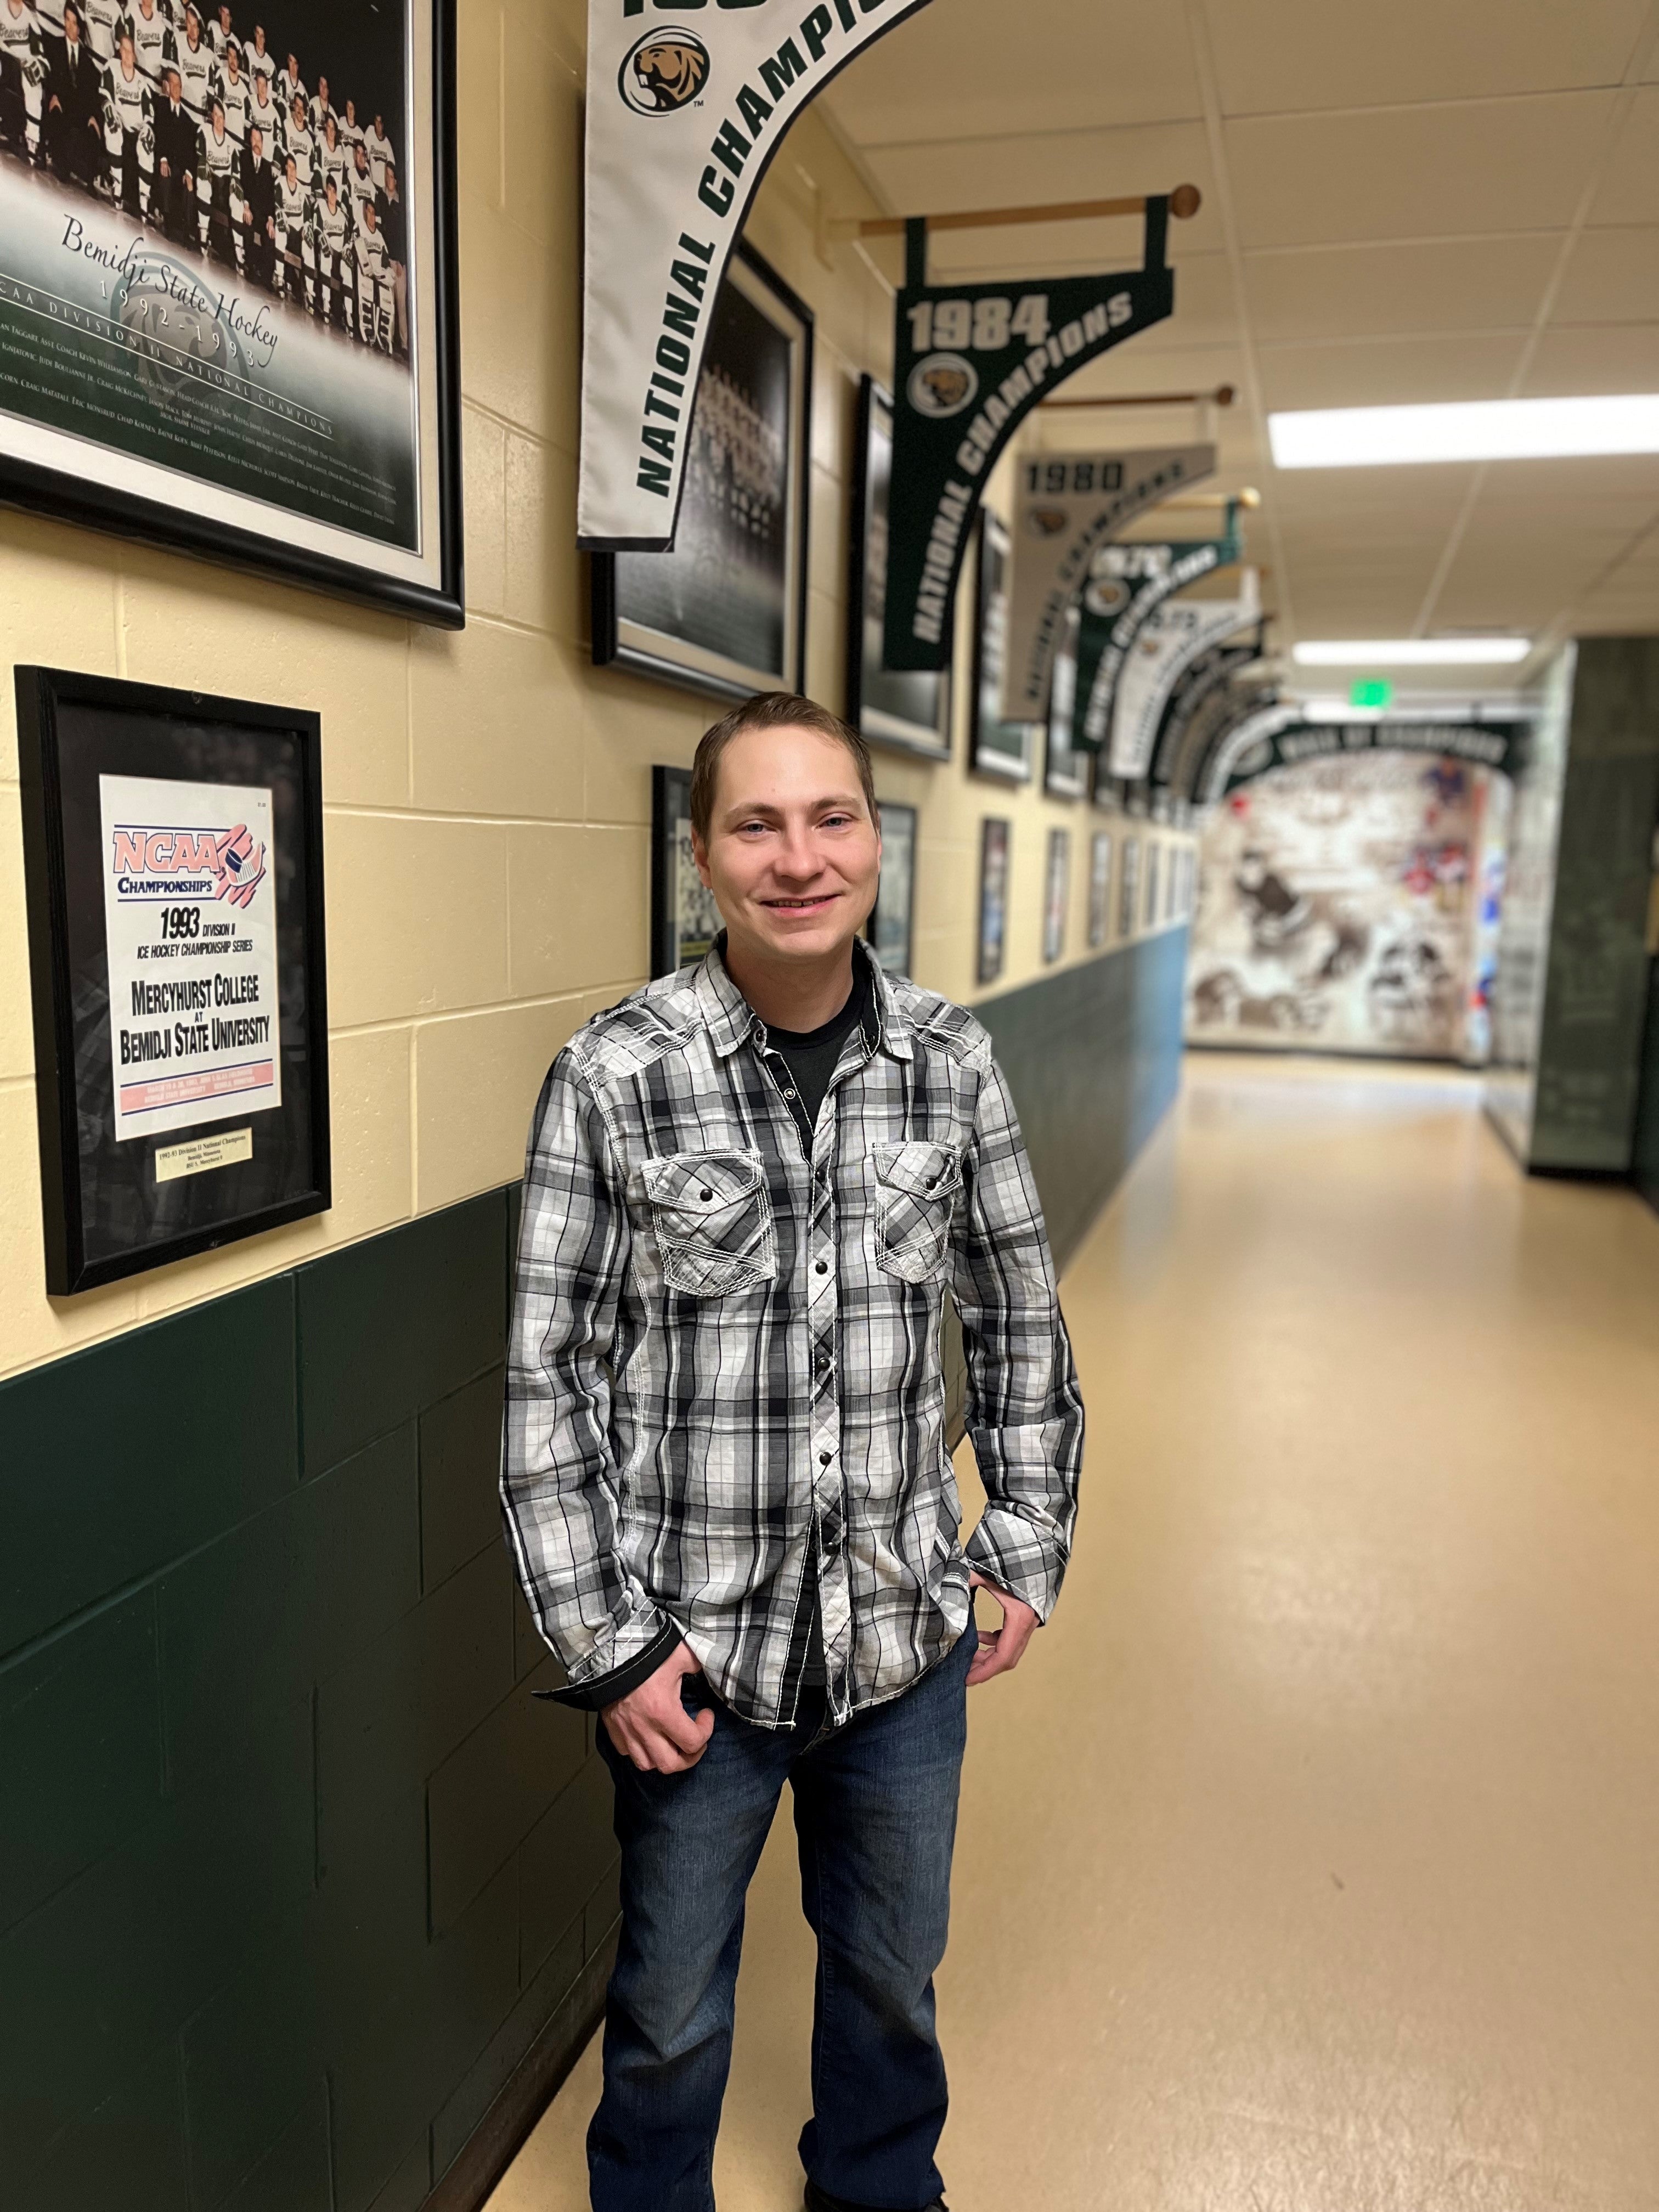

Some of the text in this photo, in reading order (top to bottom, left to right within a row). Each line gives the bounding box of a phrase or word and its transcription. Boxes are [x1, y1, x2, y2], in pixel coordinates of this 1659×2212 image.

[636, 0, 885, 498] NATIONAL CHAMPI
[62, 214, 278, 368] Bemidji State Hockey
[907, 294, 1051, 352] 1984
[50, 302, 137, 347] DIVISION
[150, 343, 160, 357] II
[176, 356, 249, 396] NATIONAL
[258, 393, 332, 435] CHAMPIONS
[56, 342, 77, 357] COACH
[79, 351, 96, 364] KEVIN
[21, 379, 40, 392] CRAIG
[913, 480, 972, 644] NATIONAL
[957, 292, 1133, 475] CHAMPIONS
[1029, 462, 1123, 492] 1980
[113, 831, 220, 873] NCAA
[117, 877, 212, 894] CHAMPIONSHIPS
[161, 906, 200, 939] 1993
[202, 923, 230, 937] DIVISION
[137, 939, 253, 959] ICE HOCKEY CHAMPIONSHIP SERIES
[131, 973, 259, 1016] MERCYHURST COLLEGE
[194, 1011, 203, 1023] AT
[120, 1015, 270, 1065] BEMIDJI STATE UNIVERSITY
[159, 1150, 177, 1160] 1992-93
[178, 1147, 196, 1156] Division
[203, 1141, 221, 1150] National
[222, 1135, 246, 1145] Champions
